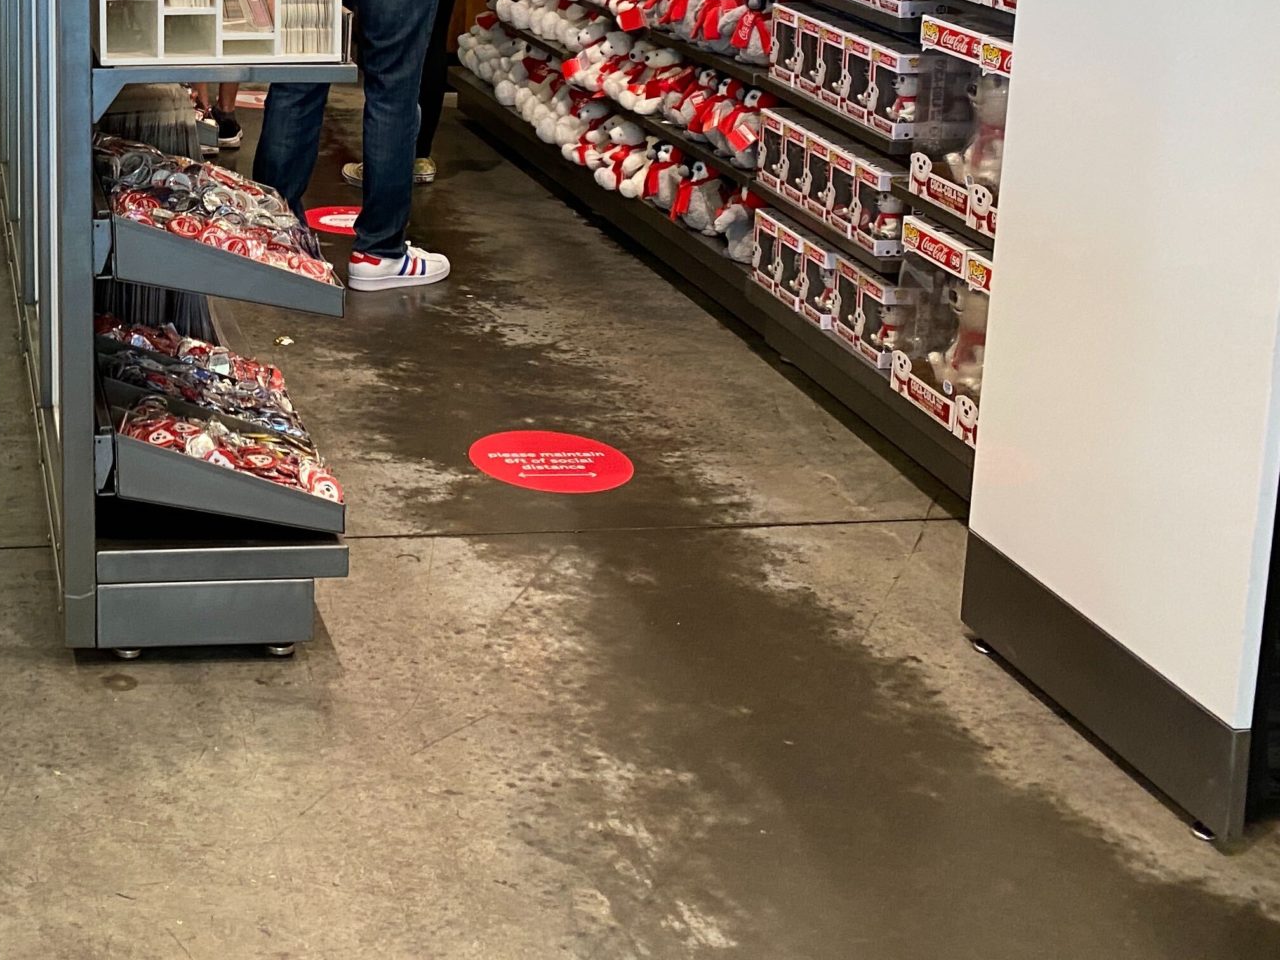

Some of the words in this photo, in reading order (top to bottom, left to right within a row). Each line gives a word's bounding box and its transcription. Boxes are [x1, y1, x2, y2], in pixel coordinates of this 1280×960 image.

[941, 30, 969, 53] Coca-Cola
[921, 237, 949, 263] Coca-Cola
[951, 256, 960, 267] 59
